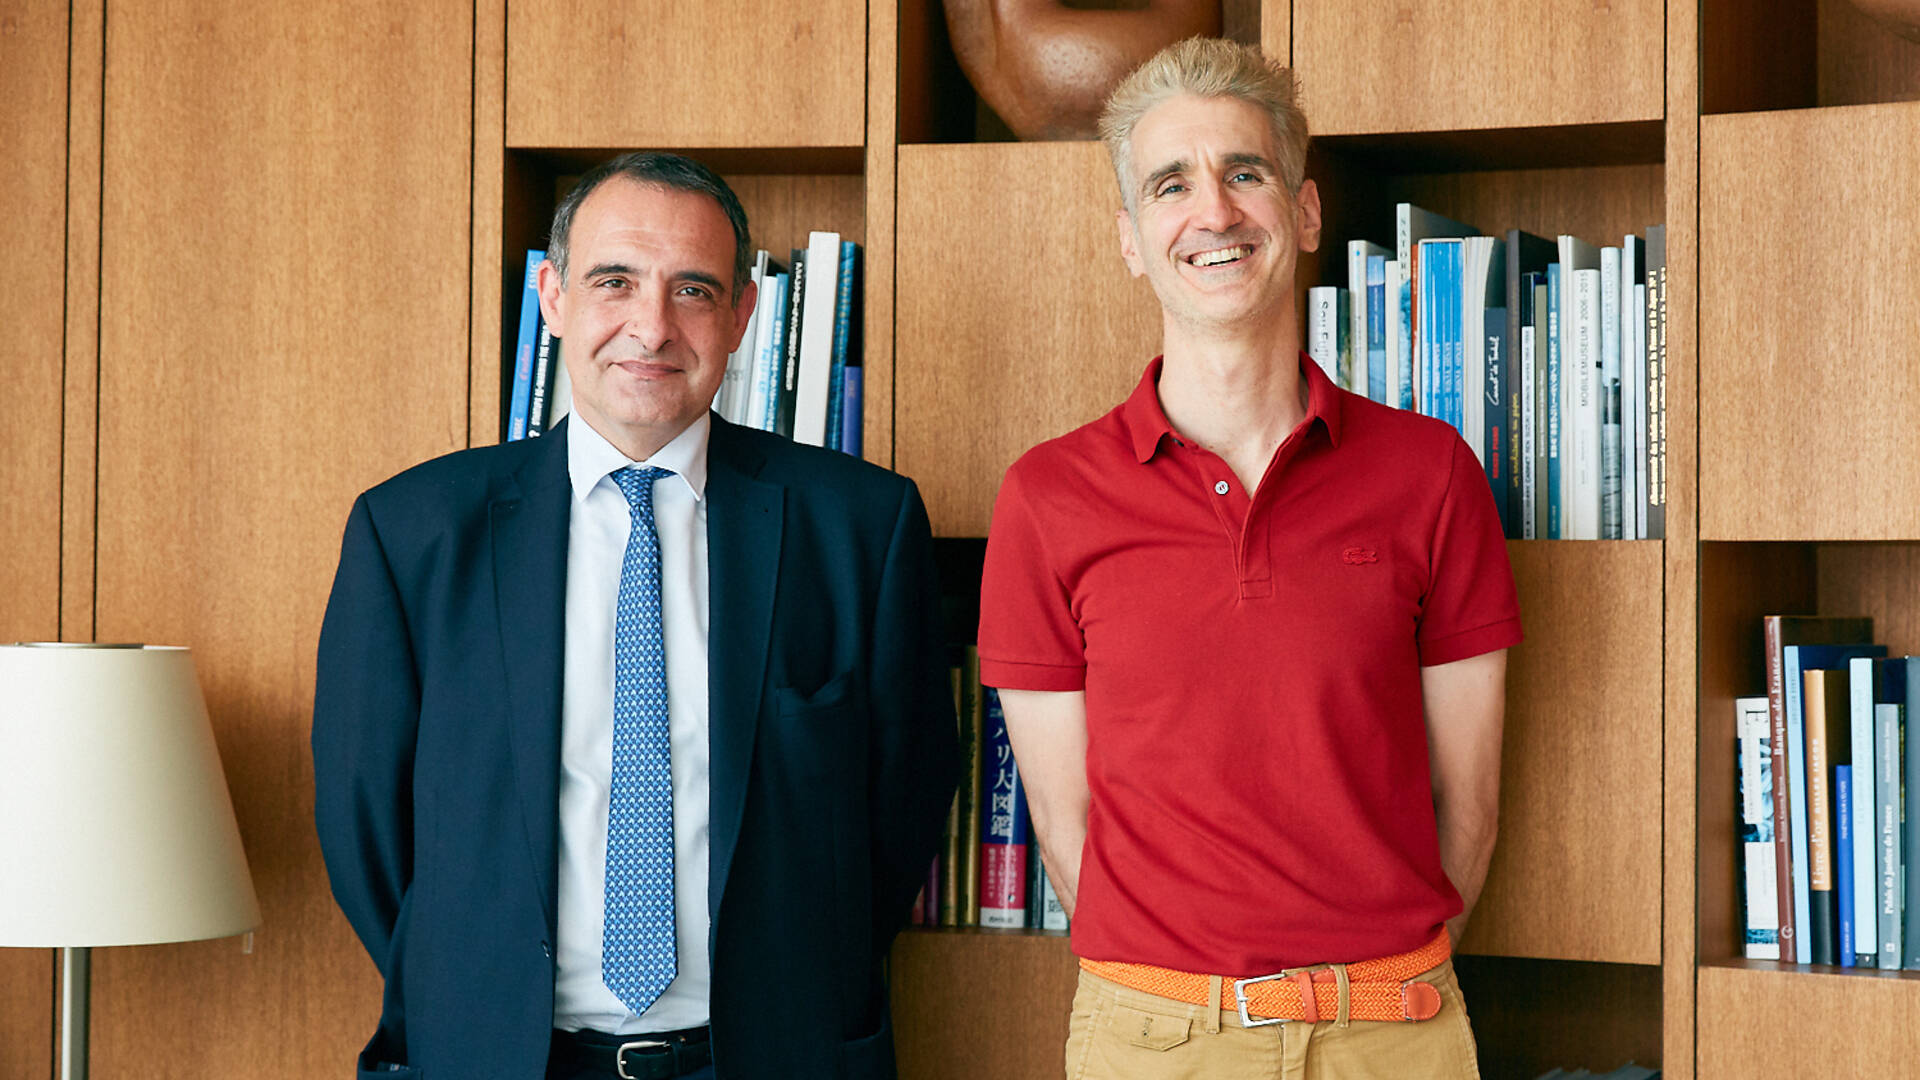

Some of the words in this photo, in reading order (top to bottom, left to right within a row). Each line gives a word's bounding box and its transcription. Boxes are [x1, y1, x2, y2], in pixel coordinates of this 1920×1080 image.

[1770, 656, 1781, 695] France
[1771, 698, 1782, 712] de
[1773, 716, 1787, 757] Banque
[1882, 804, 1893, 834] France
[1810, 820, 1824, 849] d'or
[1812, 851, 1825, 886] Livre
[1884, 888, 1894, 915] Palais
